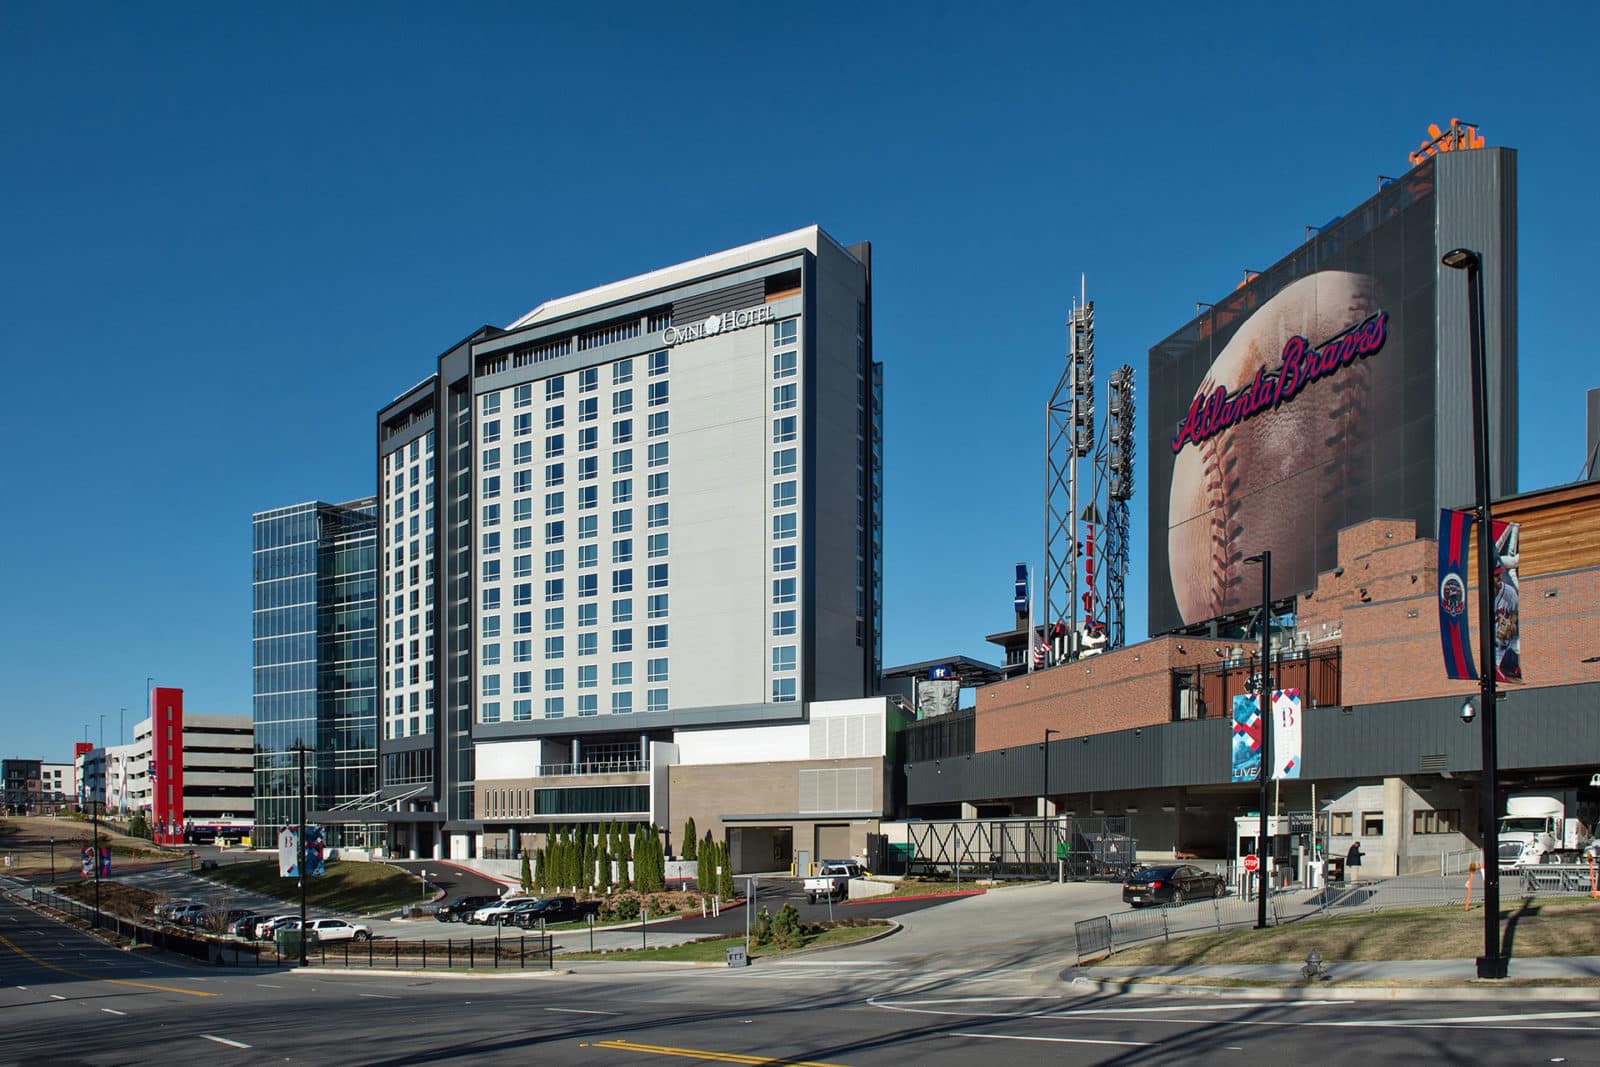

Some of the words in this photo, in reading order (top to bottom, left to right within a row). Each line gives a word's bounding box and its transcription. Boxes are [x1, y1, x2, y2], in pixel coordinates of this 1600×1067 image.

[662, 323, 705, 346] OMNI
[720, 305, 775, 331] HOTEL
[1171, 364, 1276, 454] Atlanta
[1273, 310, 1389, 409] Braves
[1244, 859, 1258, 867] STOP
